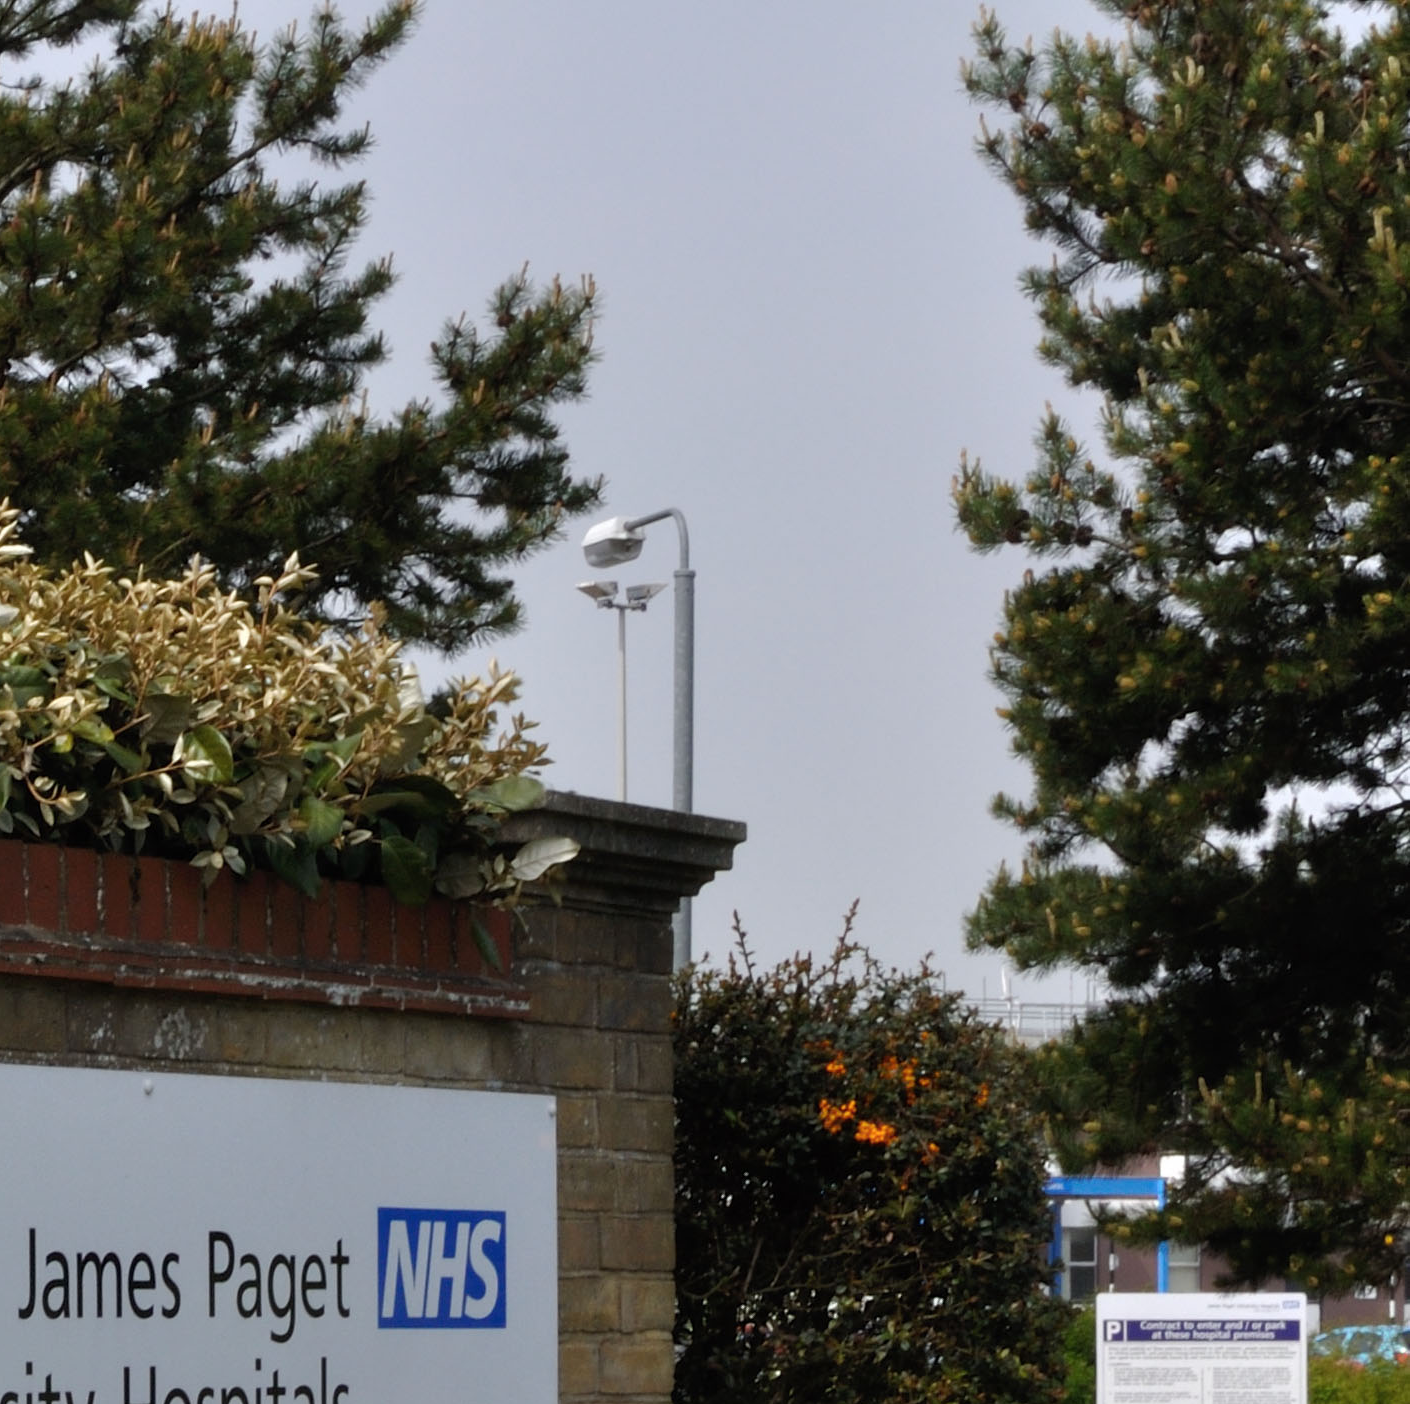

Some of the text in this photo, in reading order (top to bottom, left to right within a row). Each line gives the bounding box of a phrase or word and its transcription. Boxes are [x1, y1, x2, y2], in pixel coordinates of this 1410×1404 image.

[381, 1219, 502, 1320] NHS
[18, 1228, 351, 1344] James Paget
[1106, 1320, 1122, 1341] P
[1139, 1320, 1181, 1330] Contract
[1184, 1321, 1193, 1330] to
[1196, 1322, 1222, 1331] enter
[1224, 1320, 1243, 1330] and
[1252, 1322, 1264, 1330] or
[1265, 1320, 1286, 1331] park
[1151, 1331, 1276, 1341] at these hospital premises
